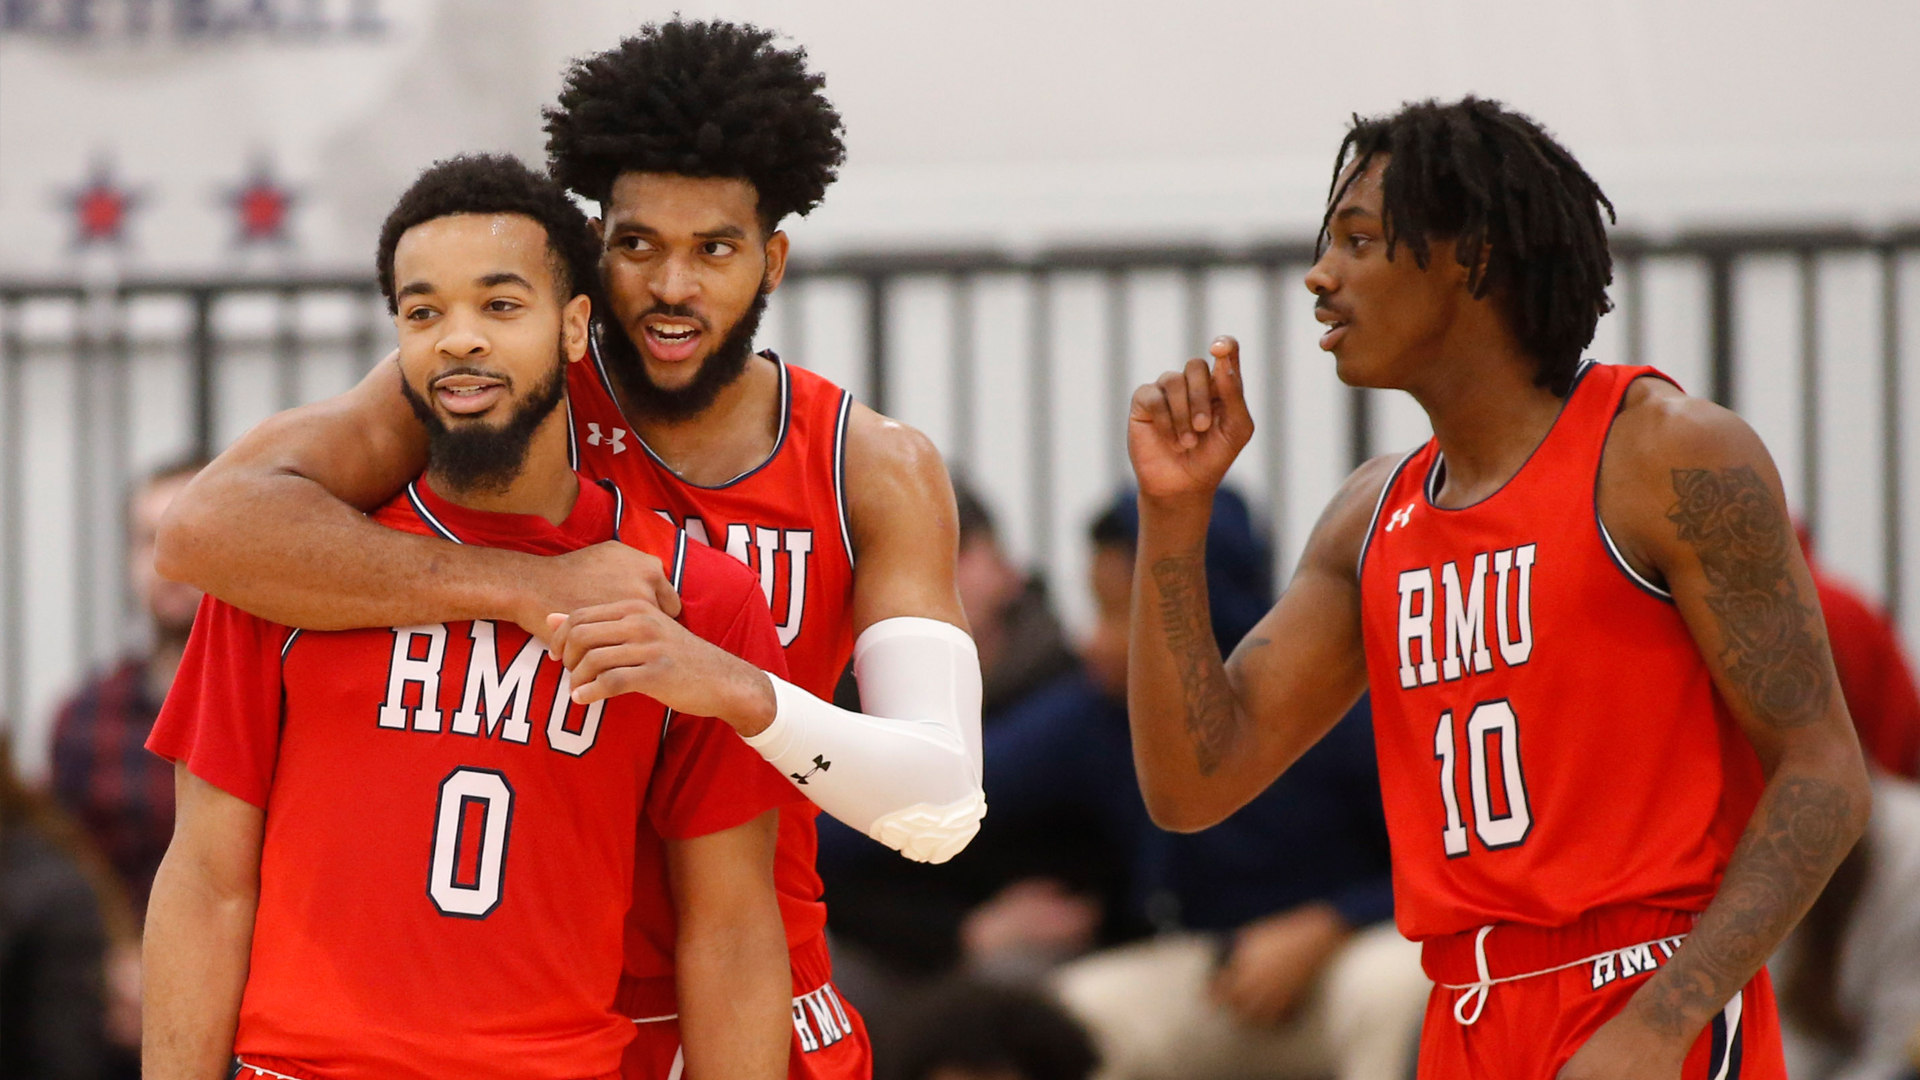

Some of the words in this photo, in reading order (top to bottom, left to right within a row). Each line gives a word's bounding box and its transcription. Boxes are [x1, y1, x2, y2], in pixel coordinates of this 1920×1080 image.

[1398, 543, 1537, 690] RMU
[426, 765, 515, 920] 0
[1434, 698, 1534, 859] 10
[792, 983, 852, 1053] RMU
